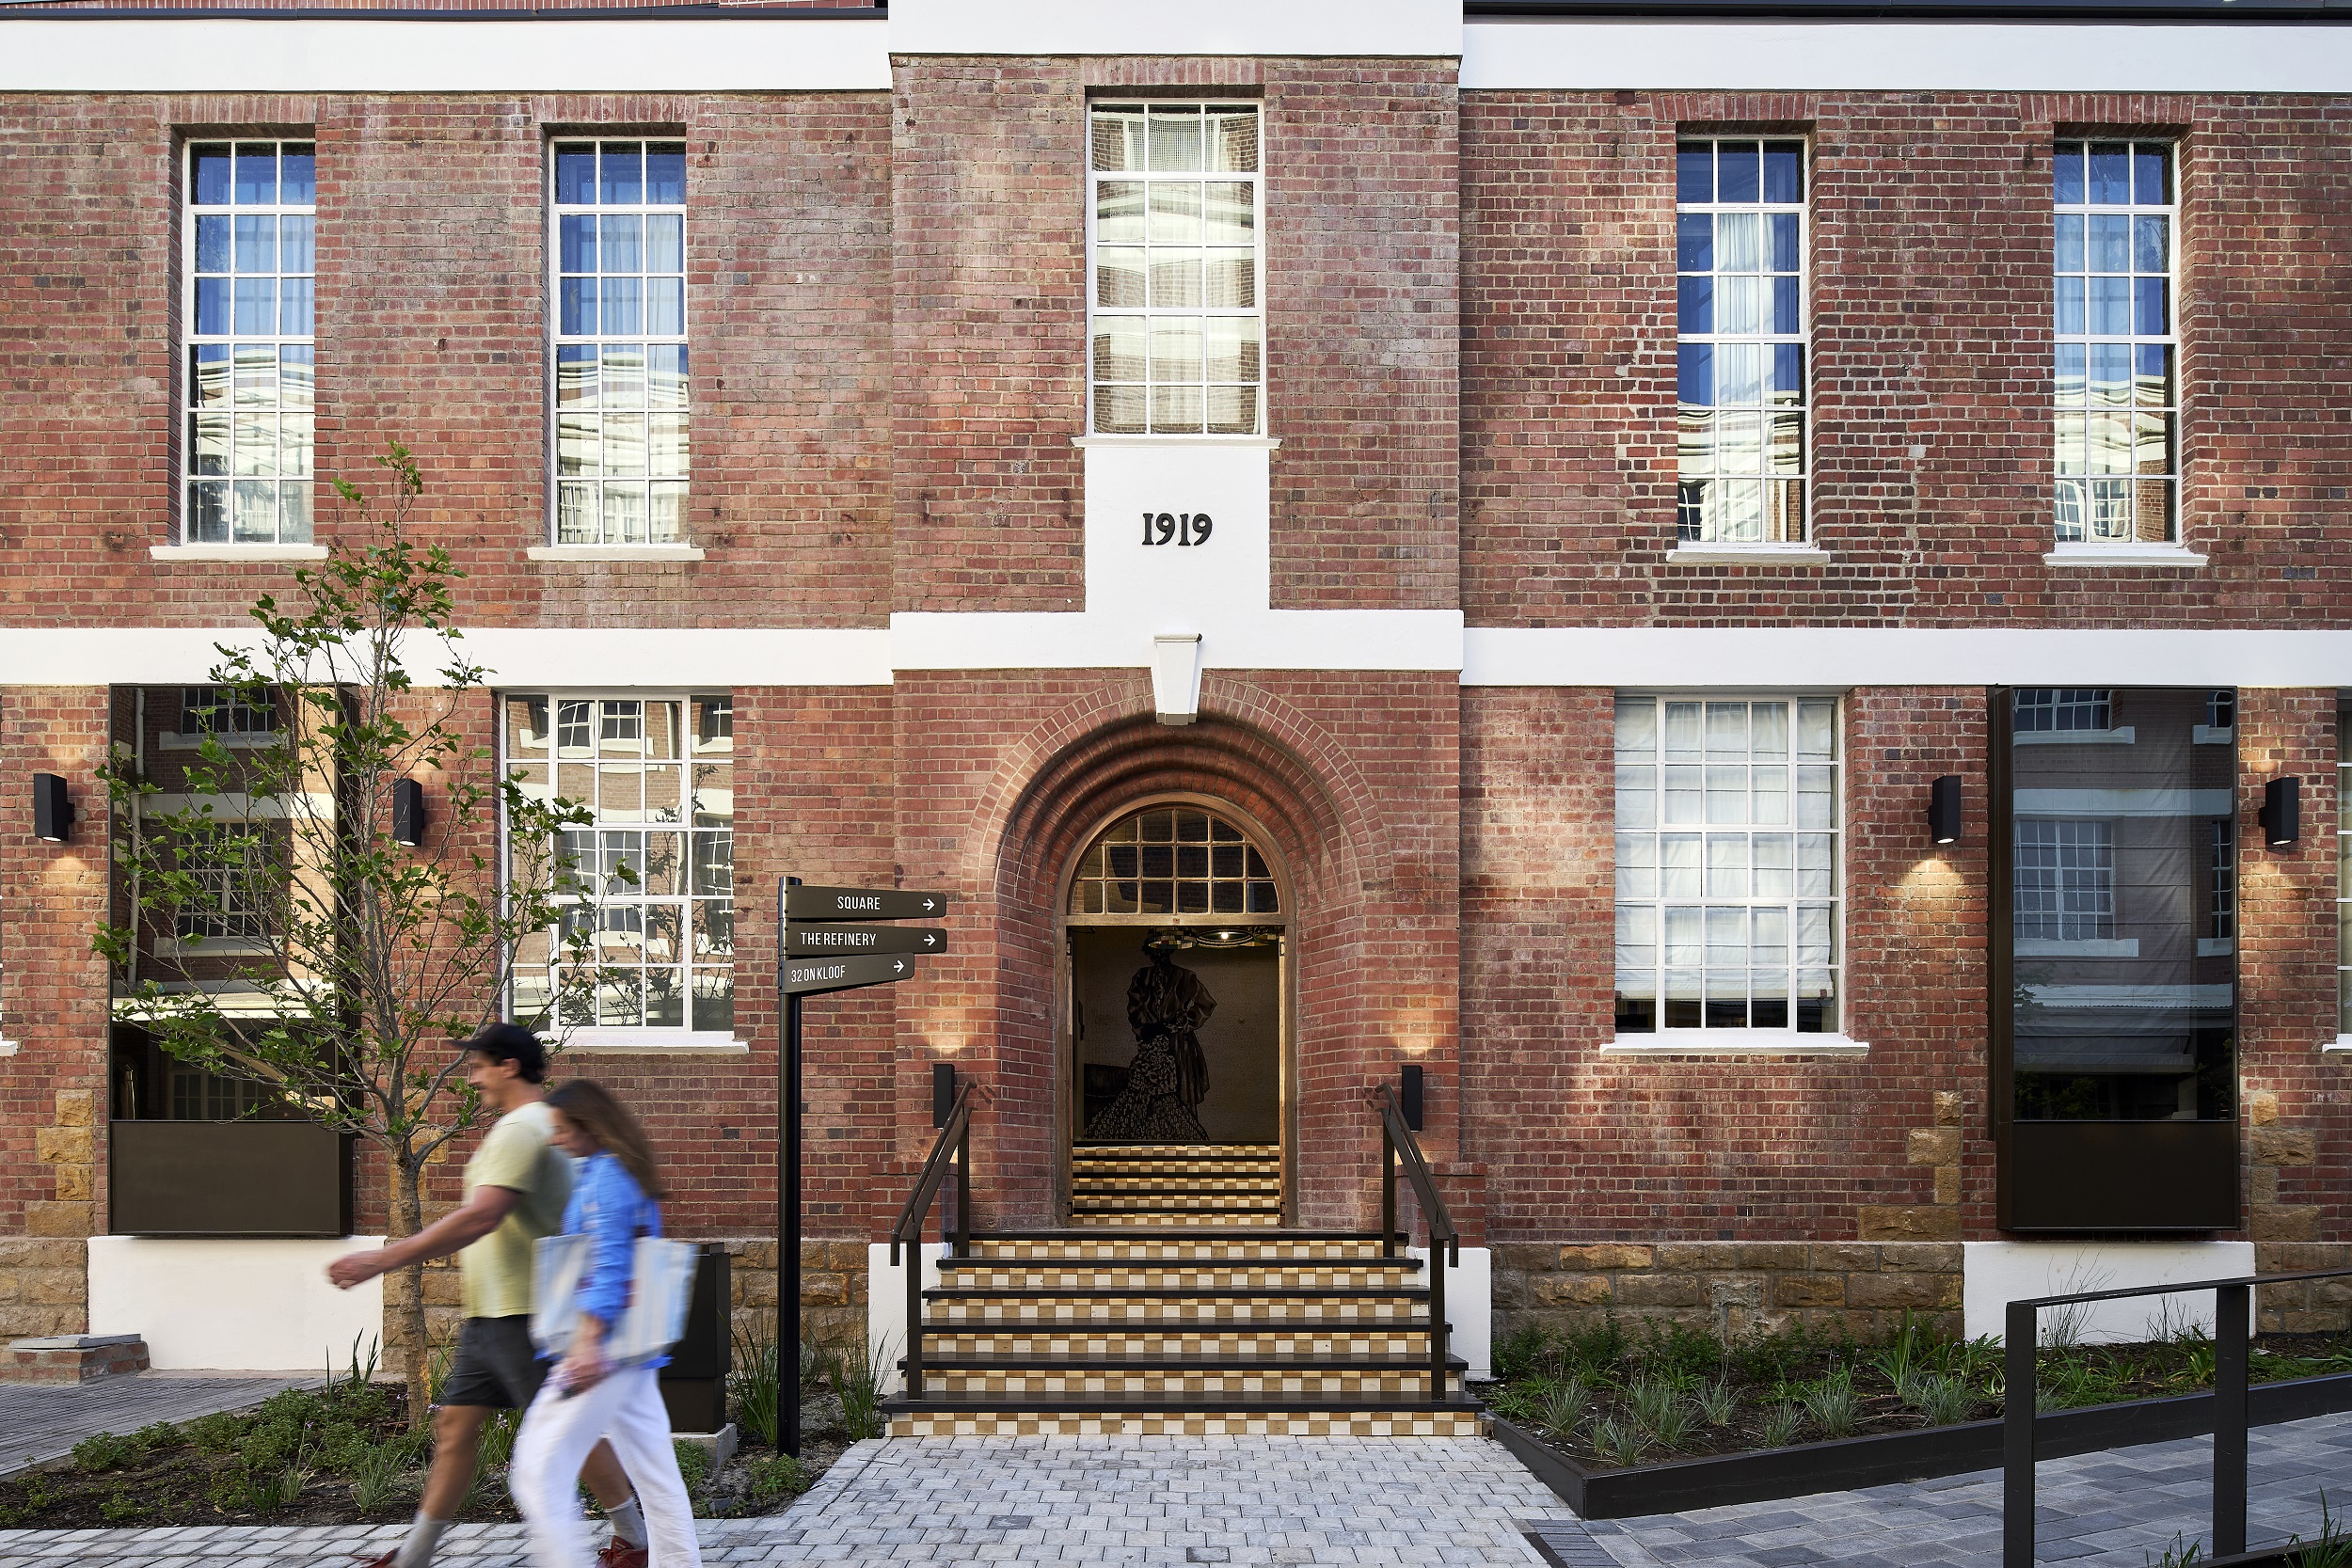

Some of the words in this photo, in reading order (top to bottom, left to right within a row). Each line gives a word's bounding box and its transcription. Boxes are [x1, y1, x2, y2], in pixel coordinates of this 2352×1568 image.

[1142, 513, 1213, 546] 1919
[836, 895, 881, 910] SQUARE
[800, 932, 821, 945] THE
[823, 932, 877, 946] REFINERY
[791, 969, 802, 983] 32
[803, 967, 816, 981] ON
[817, 965, 846, 980] KLOOF
